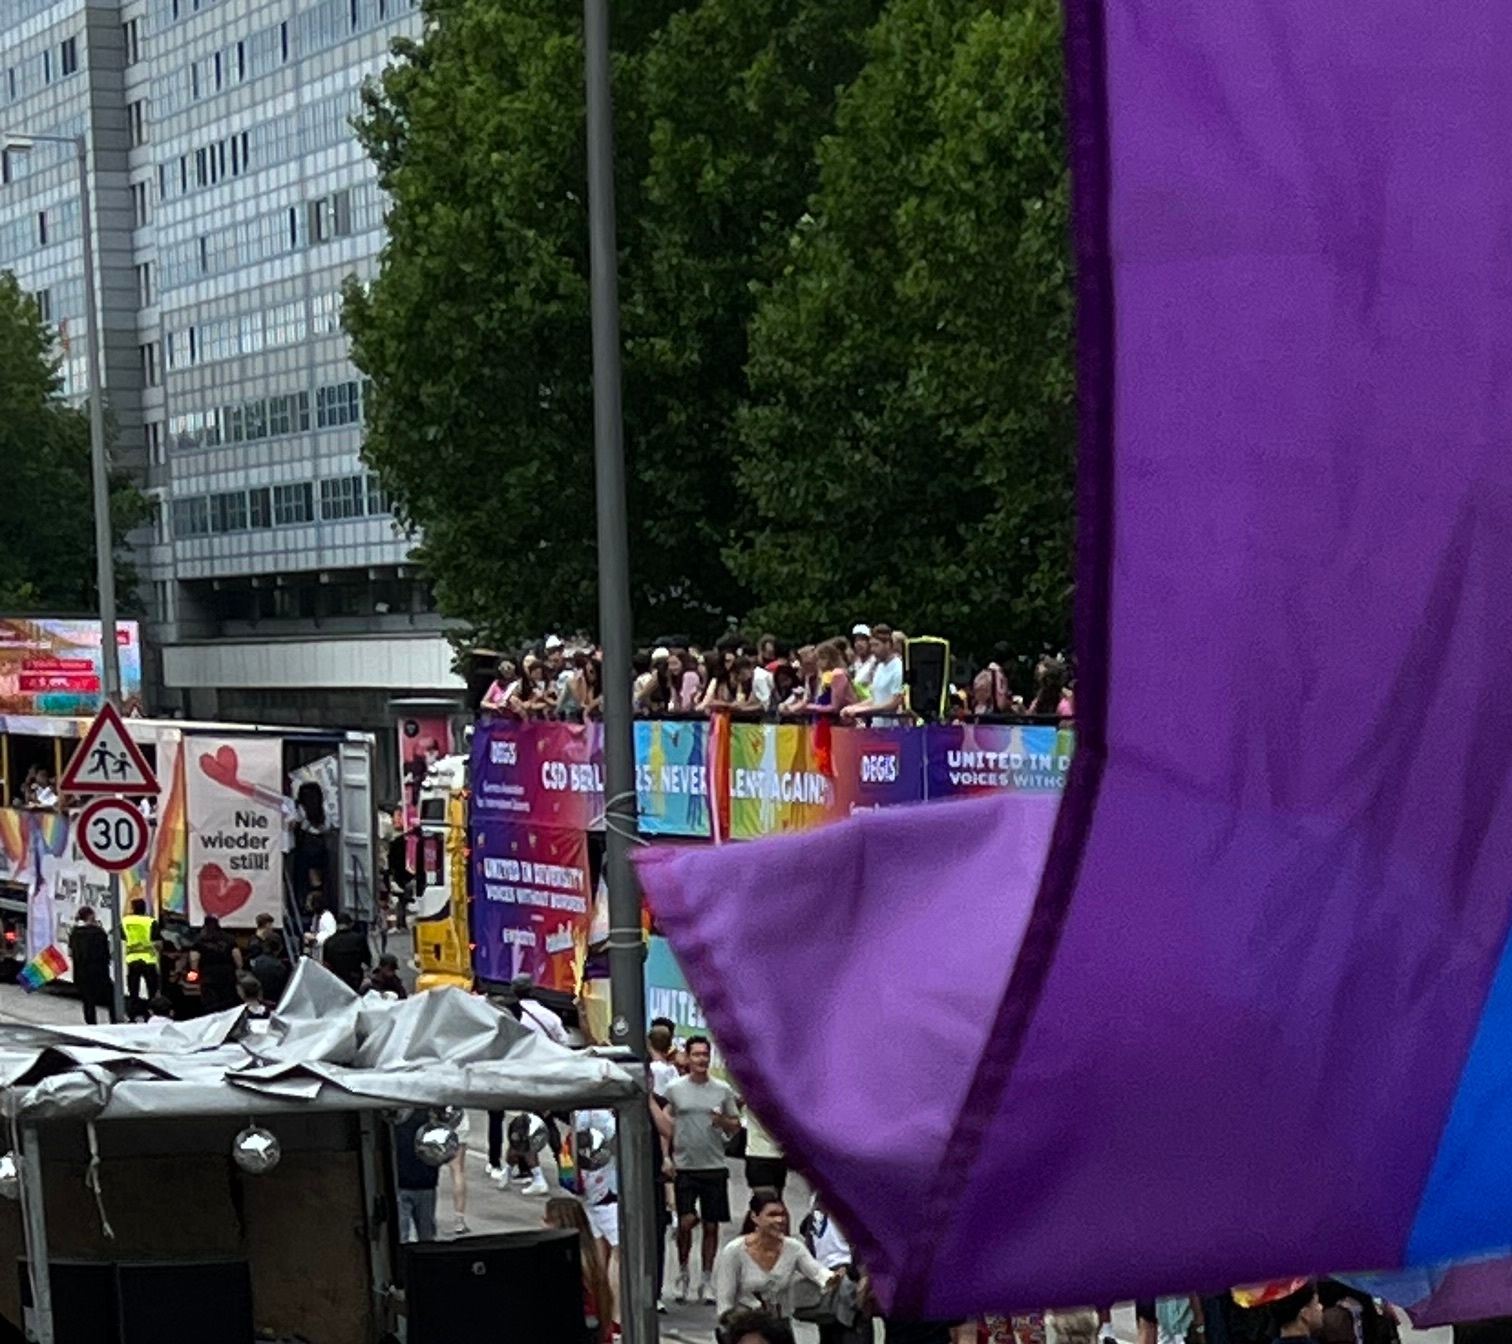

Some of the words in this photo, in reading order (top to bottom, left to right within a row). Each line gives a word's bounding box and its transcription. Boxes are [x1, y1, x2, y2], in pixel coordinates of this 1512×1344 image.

[947, 749, 1023, 770] UNITED
[1031, 752, 1051, 770] IN
[542, 762, 568, 790] CSD
[570, 762, 606, 793] BERL
[730, 769, 764, 798] LENT
[949, 772, 1009, 787] VOICES
[1013, 772, 1067, 788] WITHO
[235, 810, 268, 829] Nie
[92, 817, 134, 850] 30
[200, 830, 270, 849] wieder
[230, 853, 270, 871] still!
[648, 986, 707, 1030] UNITE
